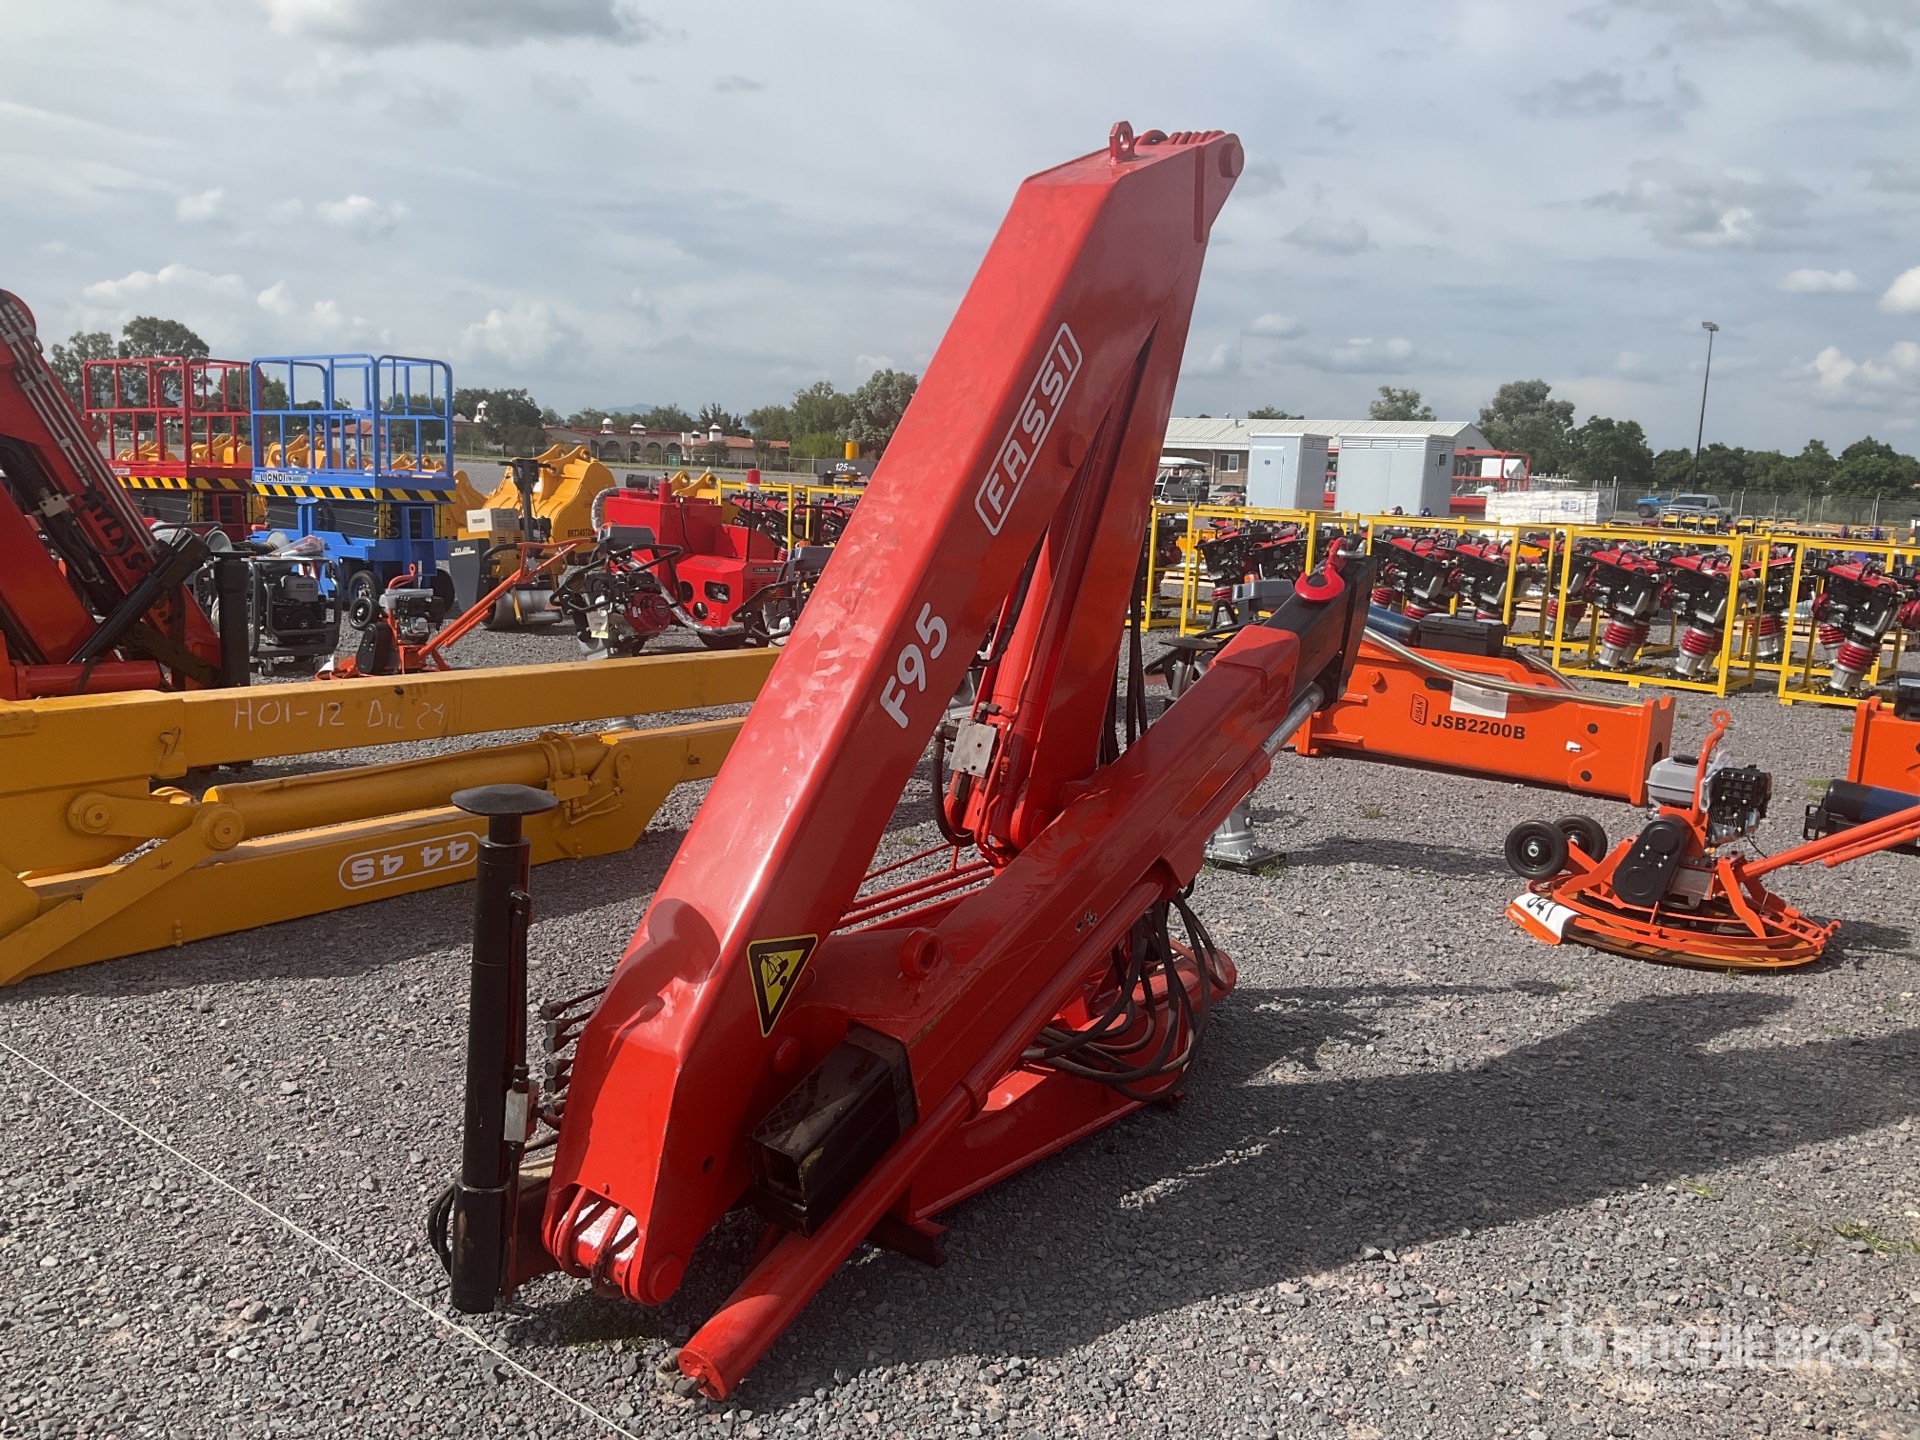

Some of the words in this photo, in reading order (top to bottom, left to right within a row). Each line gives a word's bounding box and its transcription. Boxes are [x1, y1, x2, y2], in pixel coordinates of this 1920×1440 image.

[835, 462, 849, 472] 125
[986, 344, 1073, 515] FASSI
[879, 602, 948, 729] F95
[1431, 713, 1526, 740] JSB2200B
